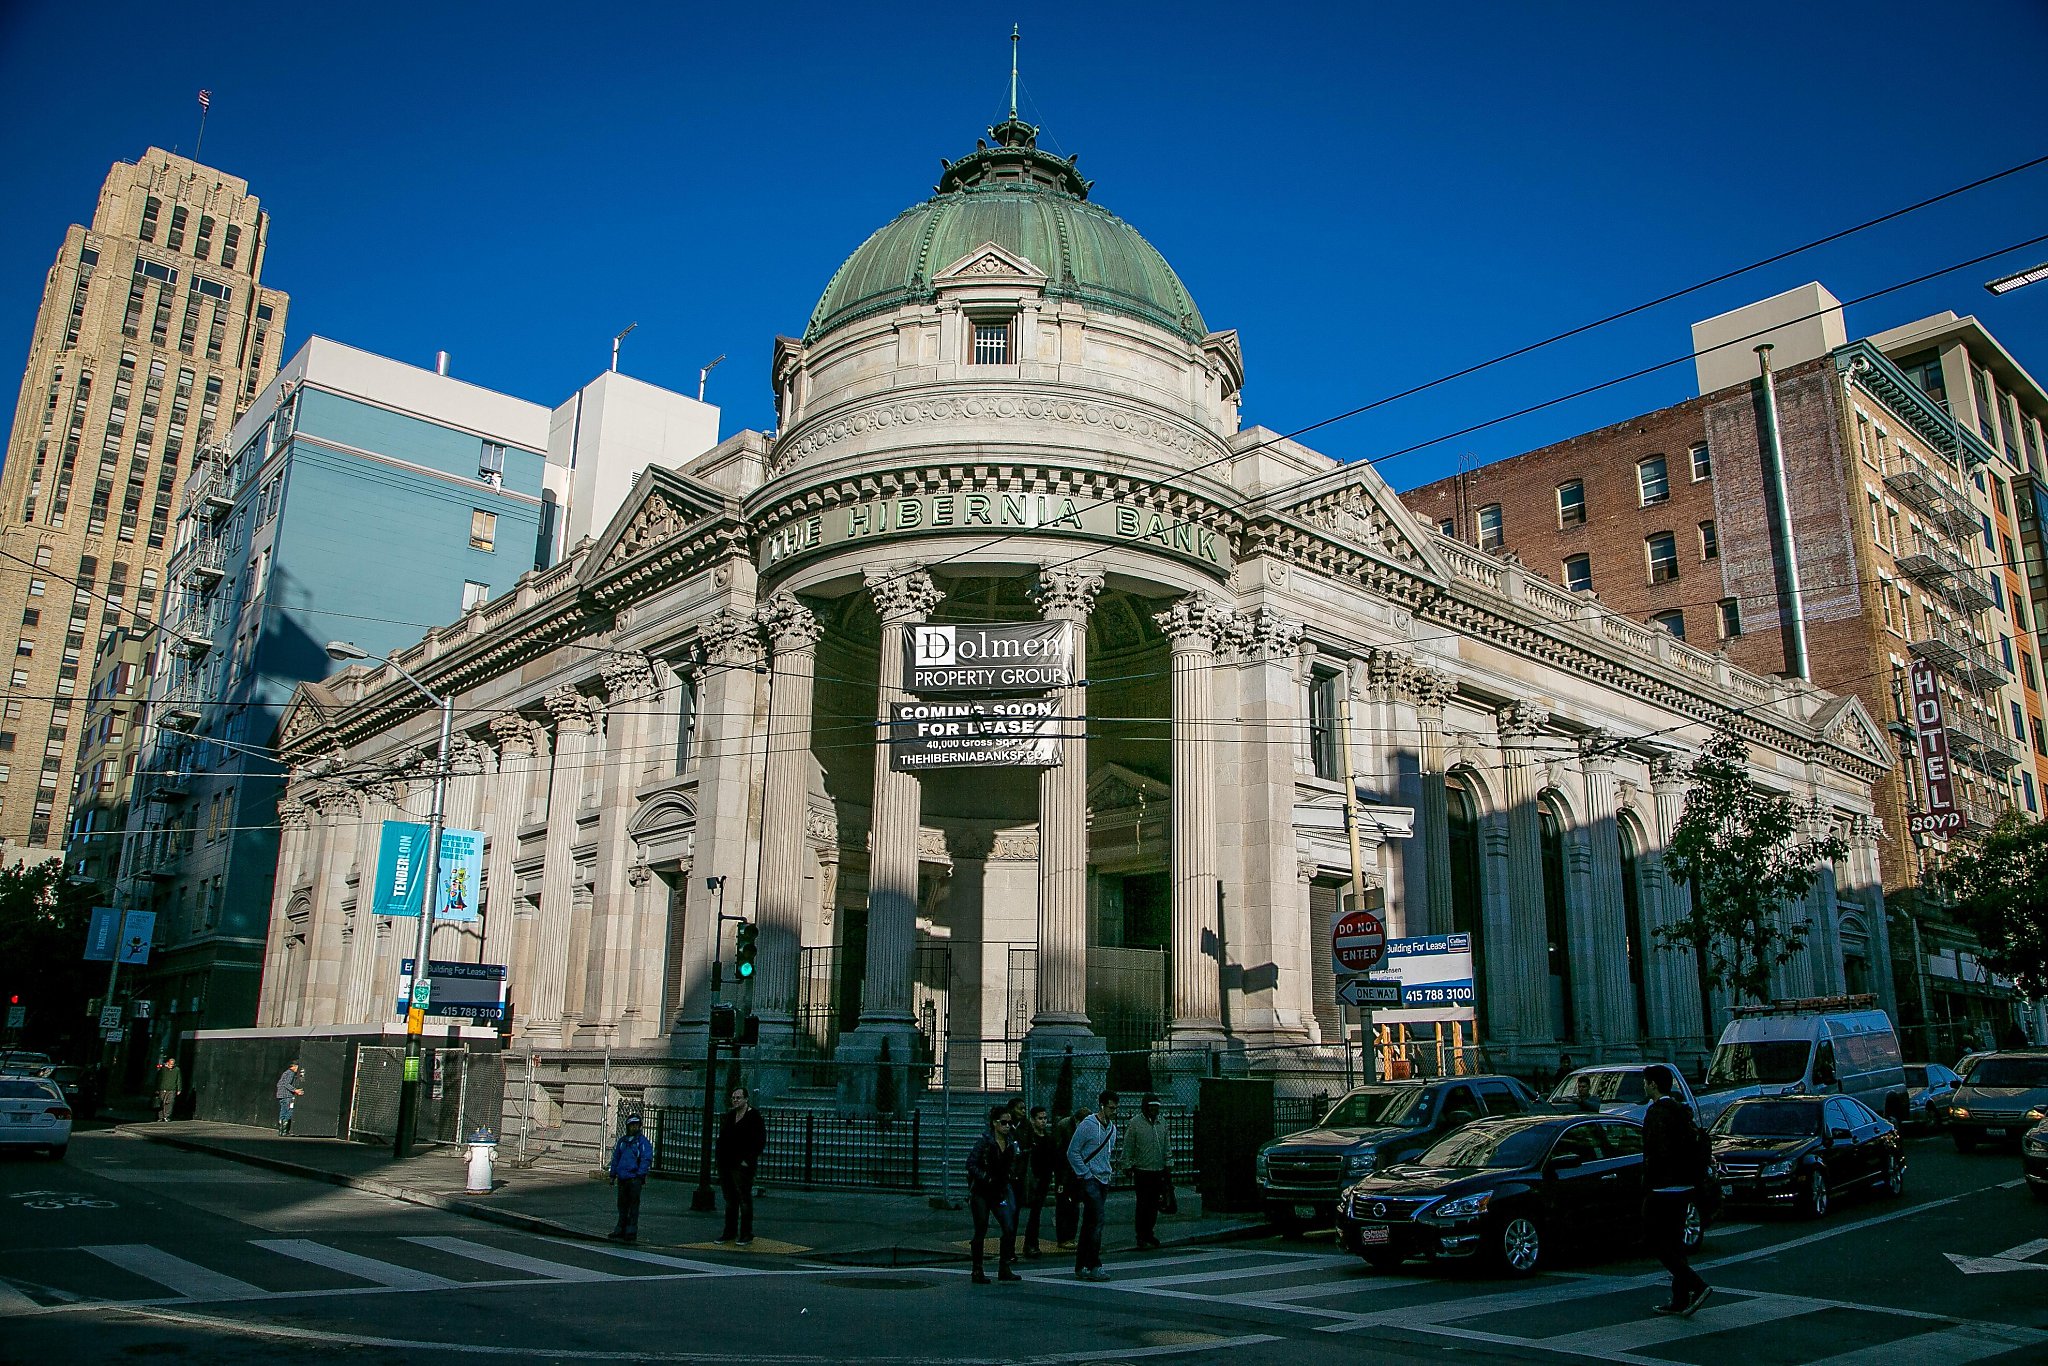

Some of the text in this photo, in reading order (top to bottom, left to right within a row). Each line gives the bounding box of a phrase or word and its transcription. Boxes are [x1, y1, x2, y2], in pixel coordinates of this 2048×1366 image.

[769, 494, 1216, 562] THE HIBERNIA BANK
[921, 632, 1061, 661] Dolmen
[915, 668, 1063, 686] PROPERTY GROUP
[993, 702, 1051, 717] SOON
[918, 720, 1036, 737] FOR LEASE
[926, 738, 959, 750] 40,000
[962, 738, 993, 748] Gross
[1914, 670, 1950, 809] HOTEL
[900, 750, 1052, 765] THEHIBERNIABANKSF.CO
[1911, 813, 1960, 832] BOYD
[393, 835, 412, 897] TENDERLOIN
[1339, 921, 1378, 934] DO NOT
[1412, 942, 1425, 952] For
[1425, 941, 1447, 951] Lease
[1342, 948, 1377, 961] ENTER
[454, 966, 466, 974] For
[466, 967, 487, 976] Lease
[417, 994, 426, 1002] 20
[1356, 988, 1395, 999] ONE WAY
[1405, 988, 1471, 1002] 415 788 3100
[441, 1006, 503, 1018] 415 788 3100
[101, 1017, 118, 1027] 25
